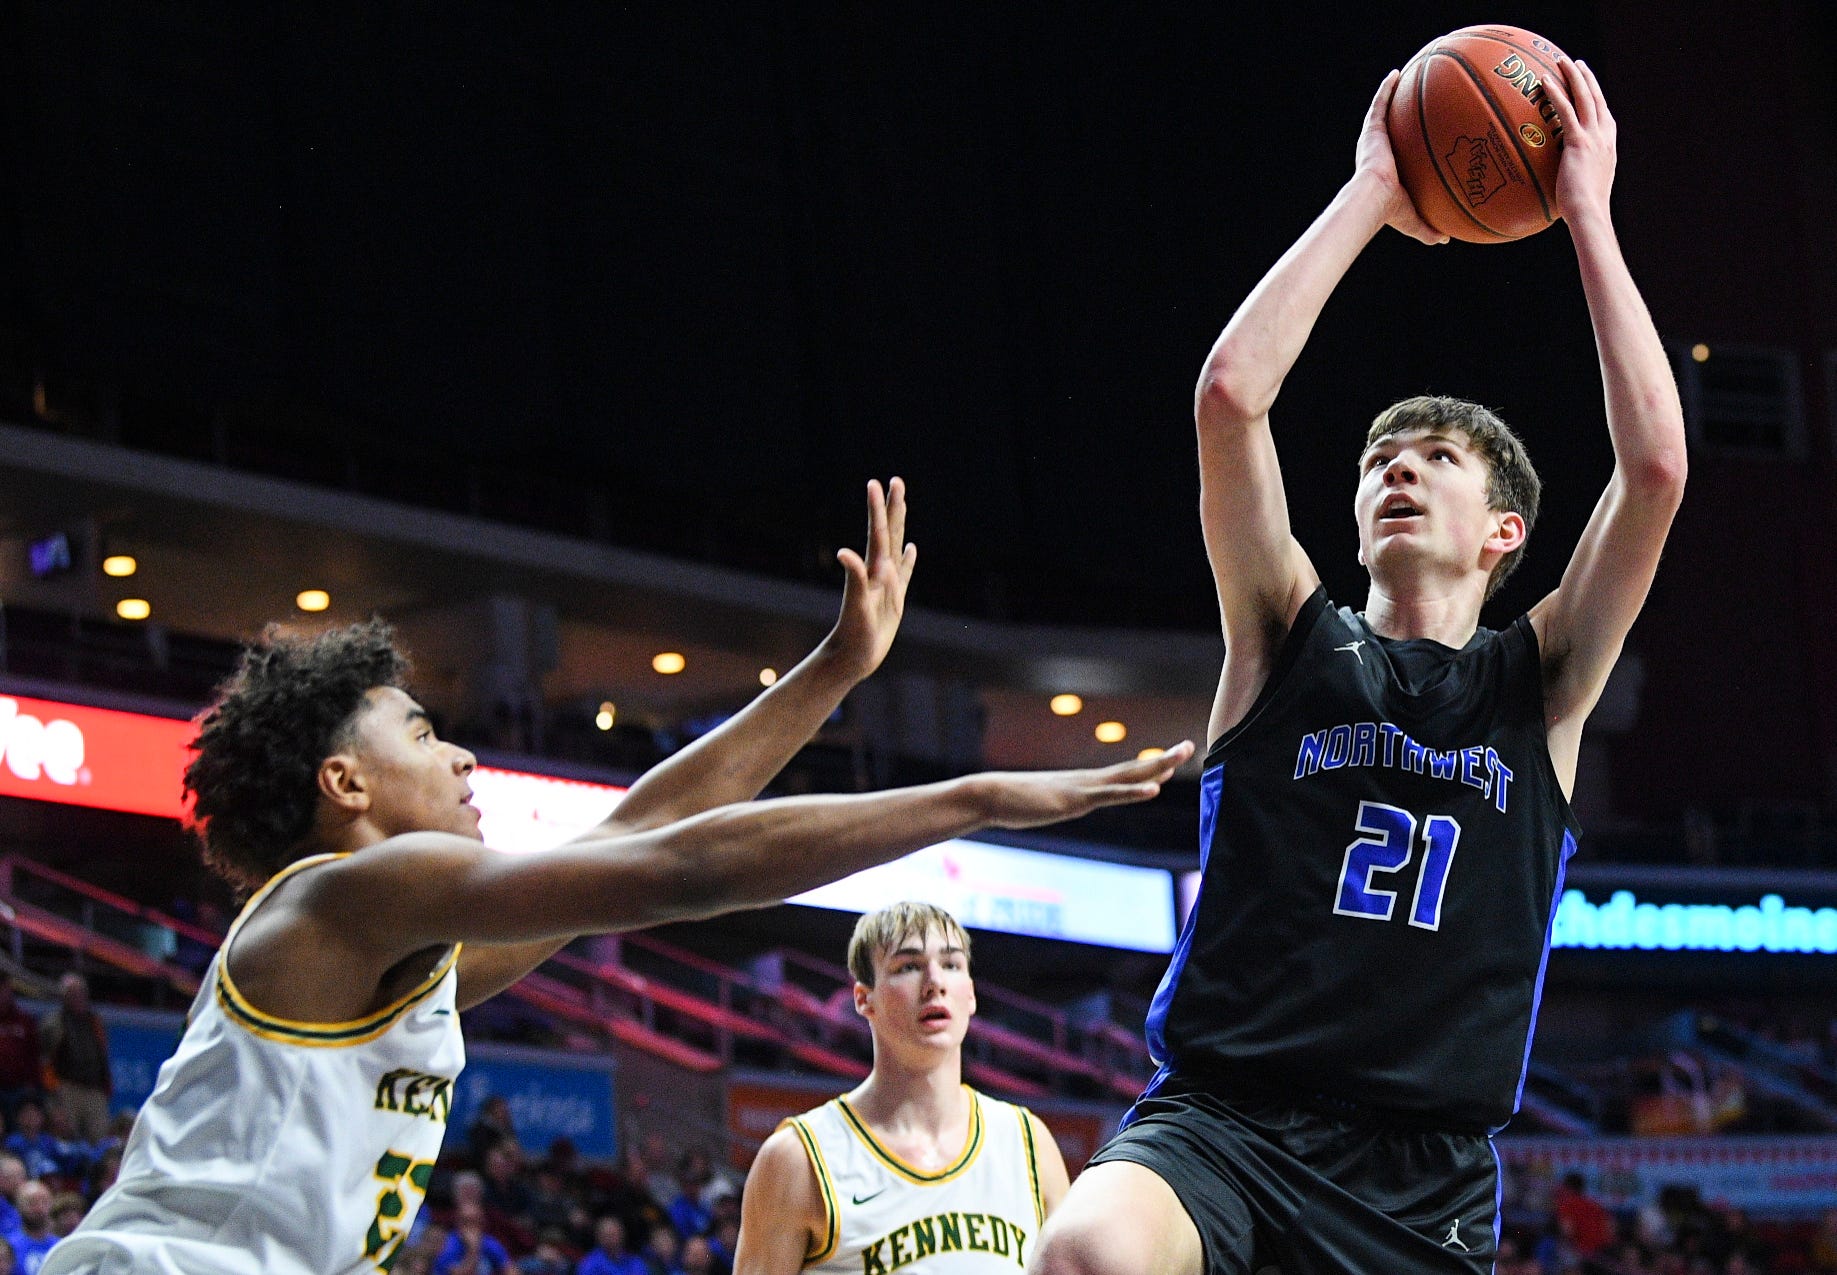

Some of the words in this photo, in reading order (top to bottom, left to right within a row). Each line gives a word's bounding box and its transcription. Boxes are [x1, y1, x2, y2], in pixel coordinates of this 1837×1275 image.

[1493, 53, 1564, 145] LDING
[1293, 722, 1513, 814] NORTHWEST
[1332, 800, 1461, 932] 21
[861, 1211, 1027, 1275] KENNEDY
